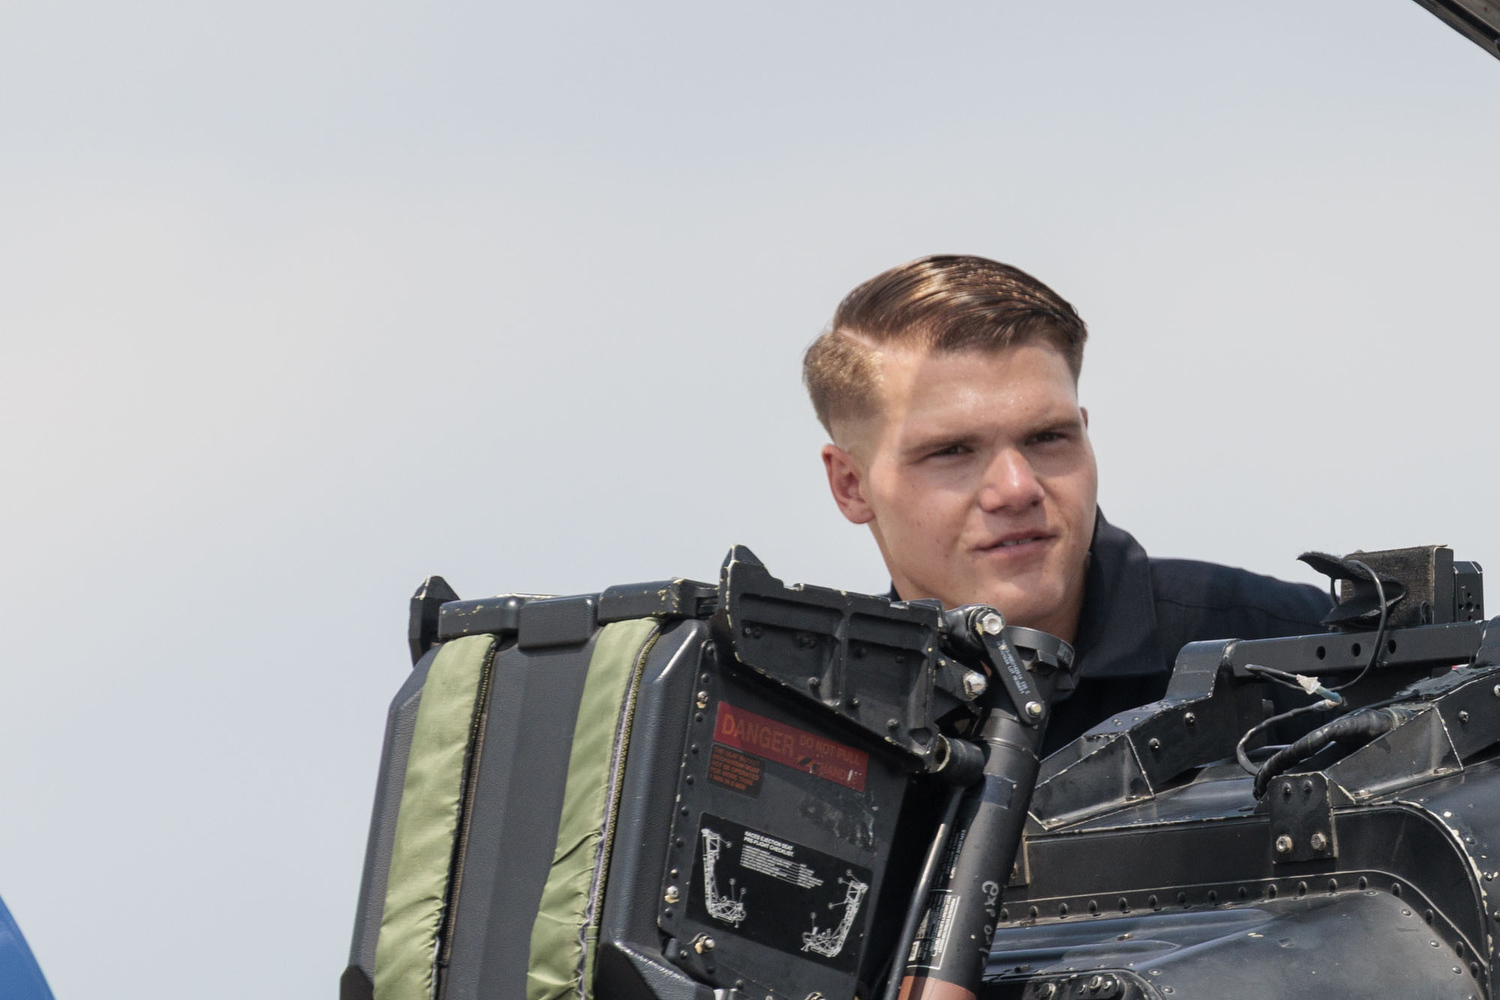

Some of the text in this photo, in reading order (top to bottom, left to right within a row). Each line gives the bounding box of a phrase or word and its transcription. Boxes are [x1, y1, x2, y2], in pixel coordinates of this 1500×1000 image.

[721, 713, 795, 757] DANGER
[800, 735, 813, 750] DO
[816, 741, 835, 756] NOT
